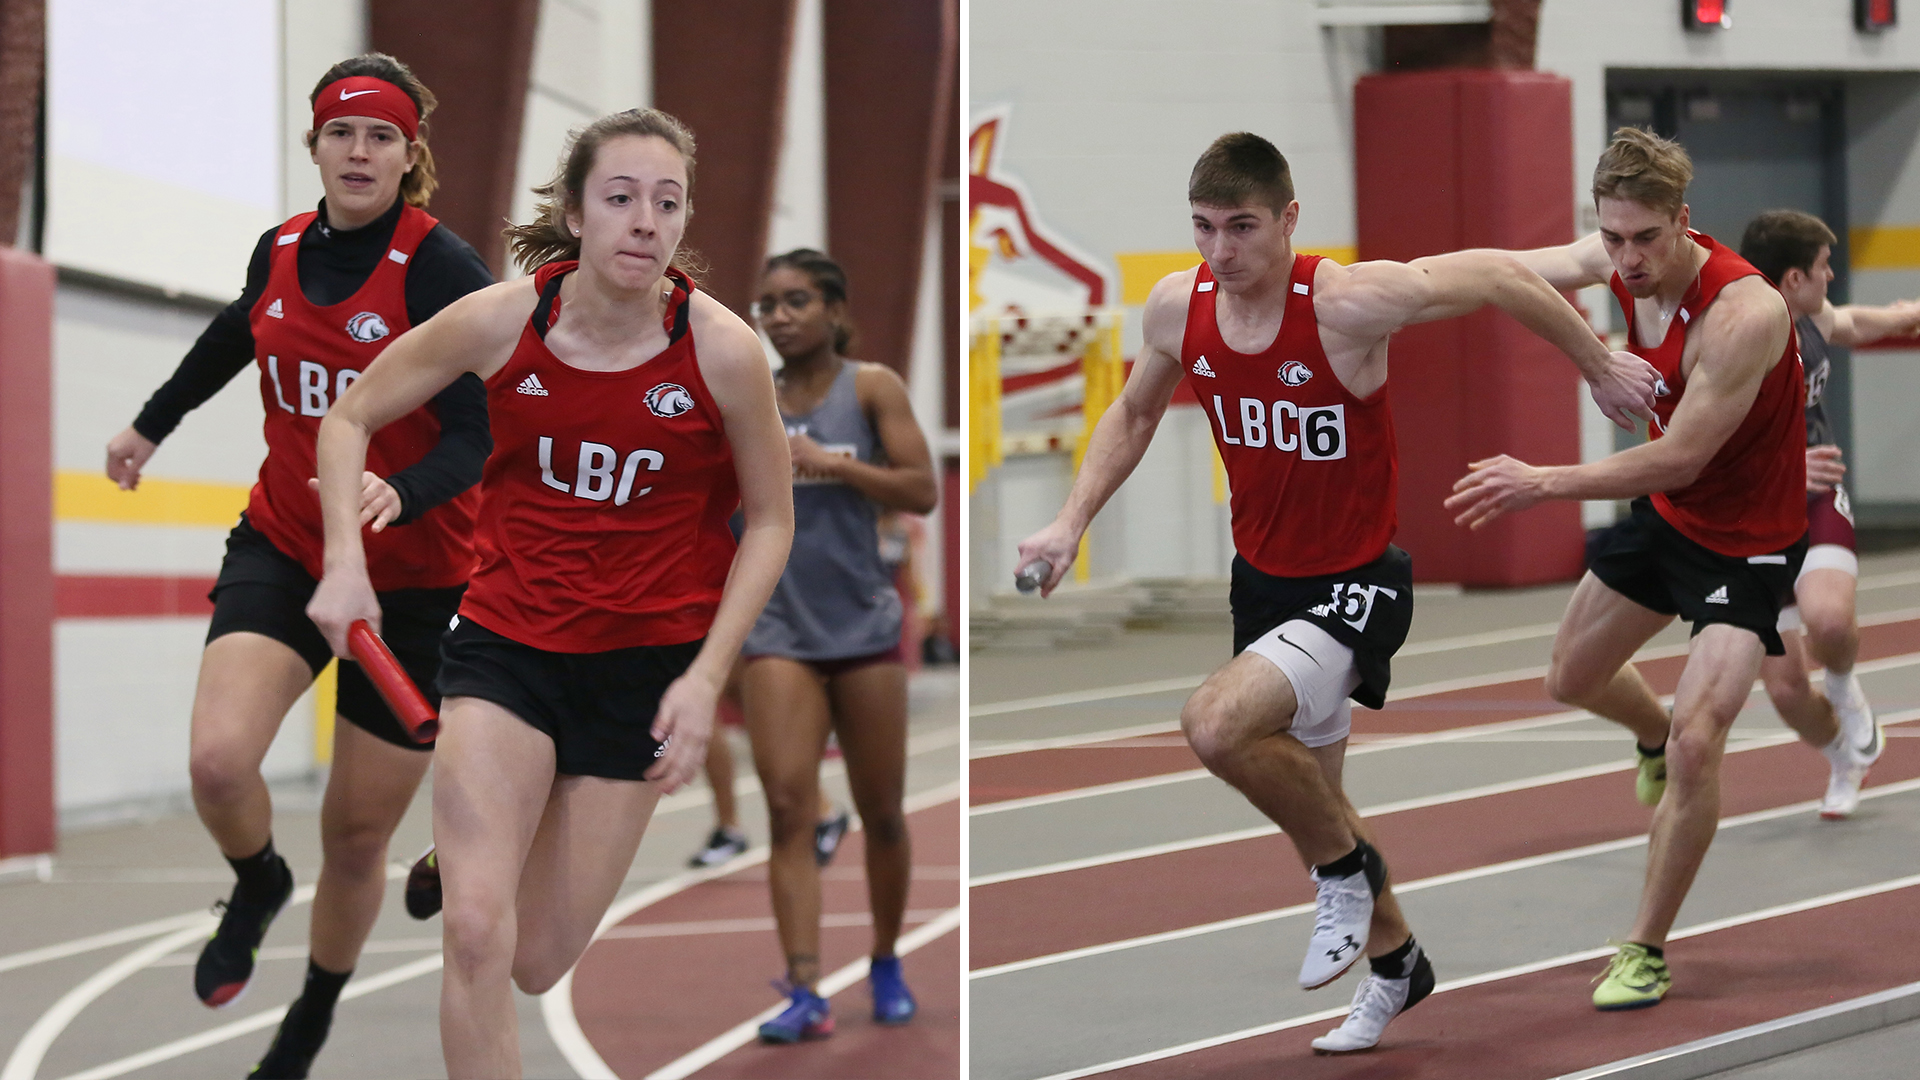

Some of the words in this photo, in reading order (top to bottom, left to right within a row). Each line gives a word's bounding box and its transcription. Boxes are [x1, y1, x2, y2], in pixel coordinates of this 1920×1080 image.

[516, 386, 549, 396] adidas
[1192, 367, 1216, 378] adidas
[1213, 394, 1298, 452] LBC
[1305, 409, 1340, 457] 6
[538, 435, 665, 507] LBC
